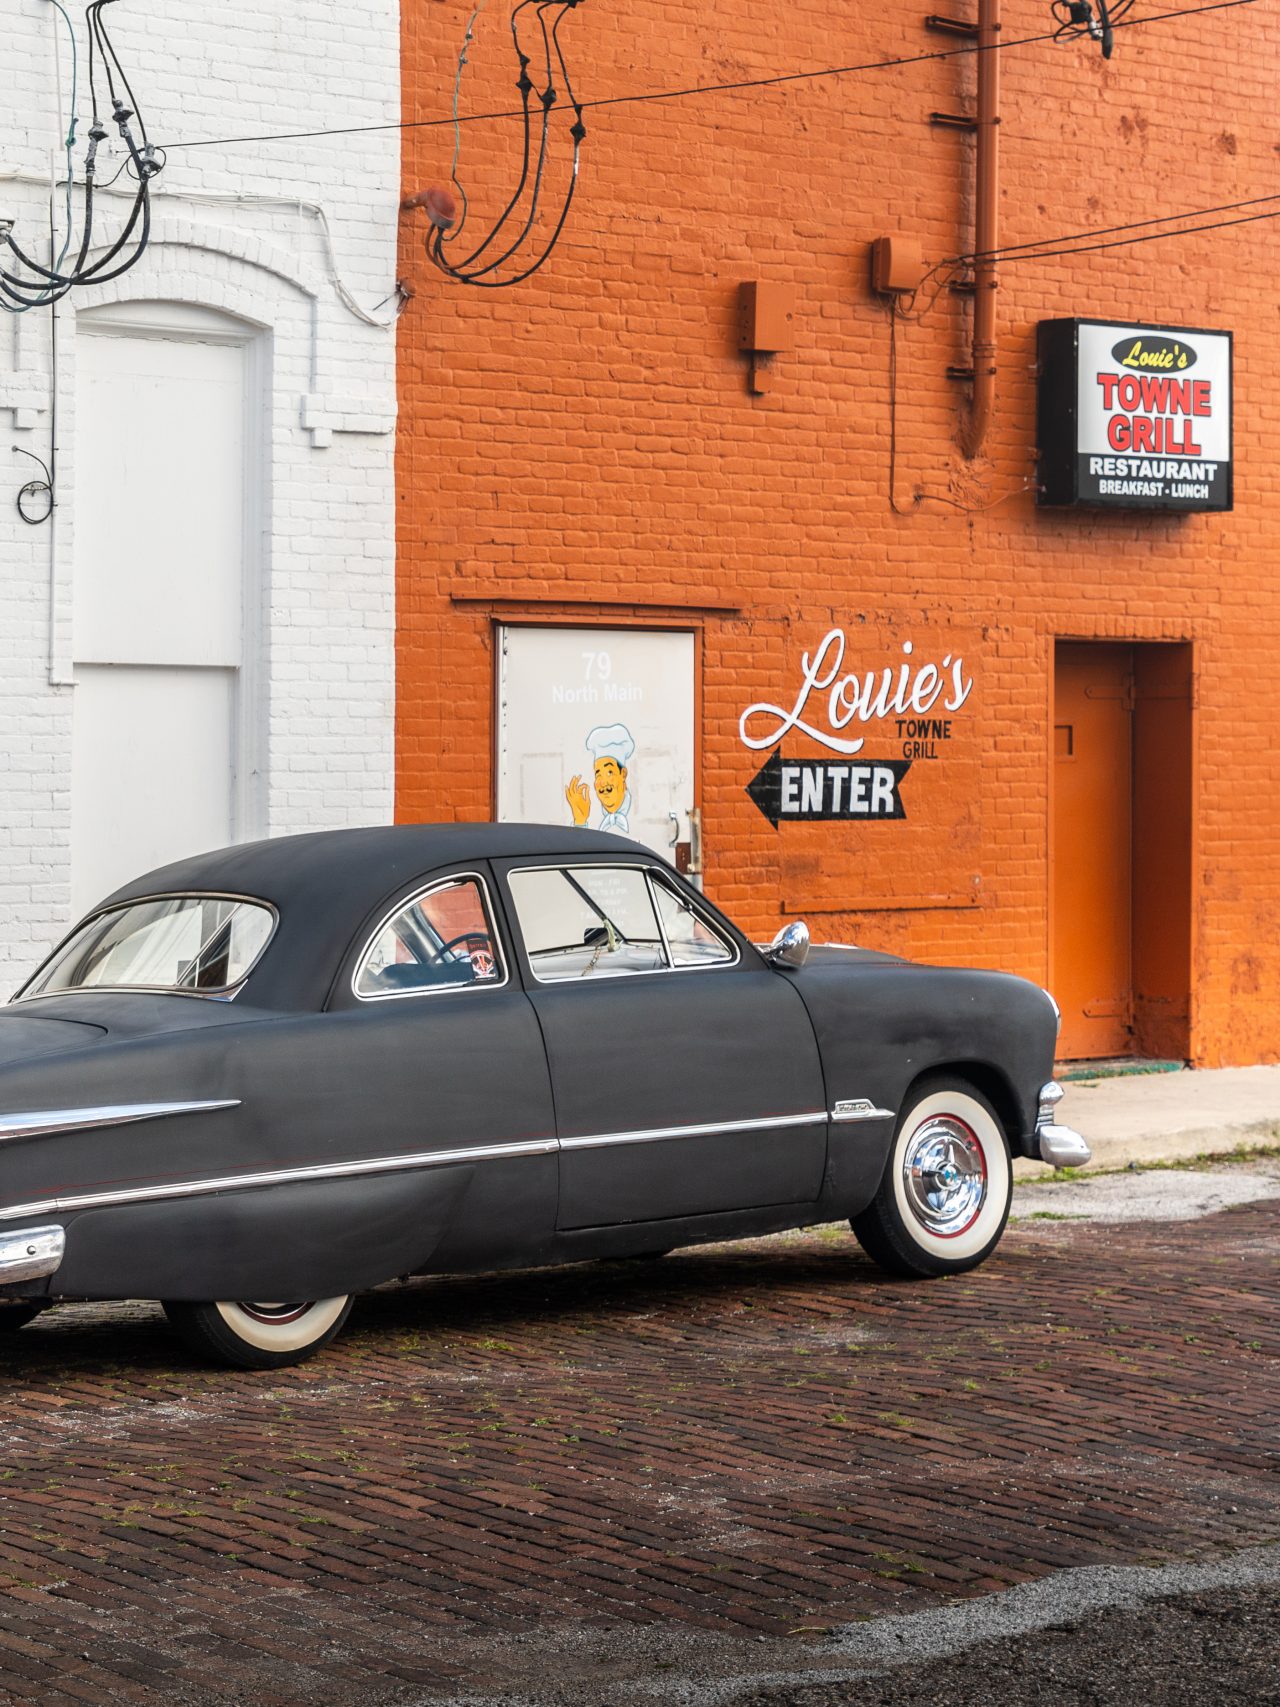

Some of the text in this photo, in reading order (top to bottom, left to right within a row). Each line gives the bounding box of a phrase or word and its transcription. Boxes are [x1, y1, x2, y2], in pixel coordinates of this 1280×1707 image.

[1121, 340, 1188, 369] Louie's
[1097, 372, 1212, 417] TOWNE
[1107, 414, 1202, 456] GRILL
[1089, 456, 1218, 481] RESTAURANT
[1099, 479, 1209, 498] BREAKFAST LUNCH
[581, 652, 613, 681] 79
[552, 683, 644, 704] North Main
[738, 627, 974, 755] Louie's
[895, 719, 952, 739] TOWNE
[903, 741, 939, 759] GRILL
[780, 766, 896, 813] ENTER
